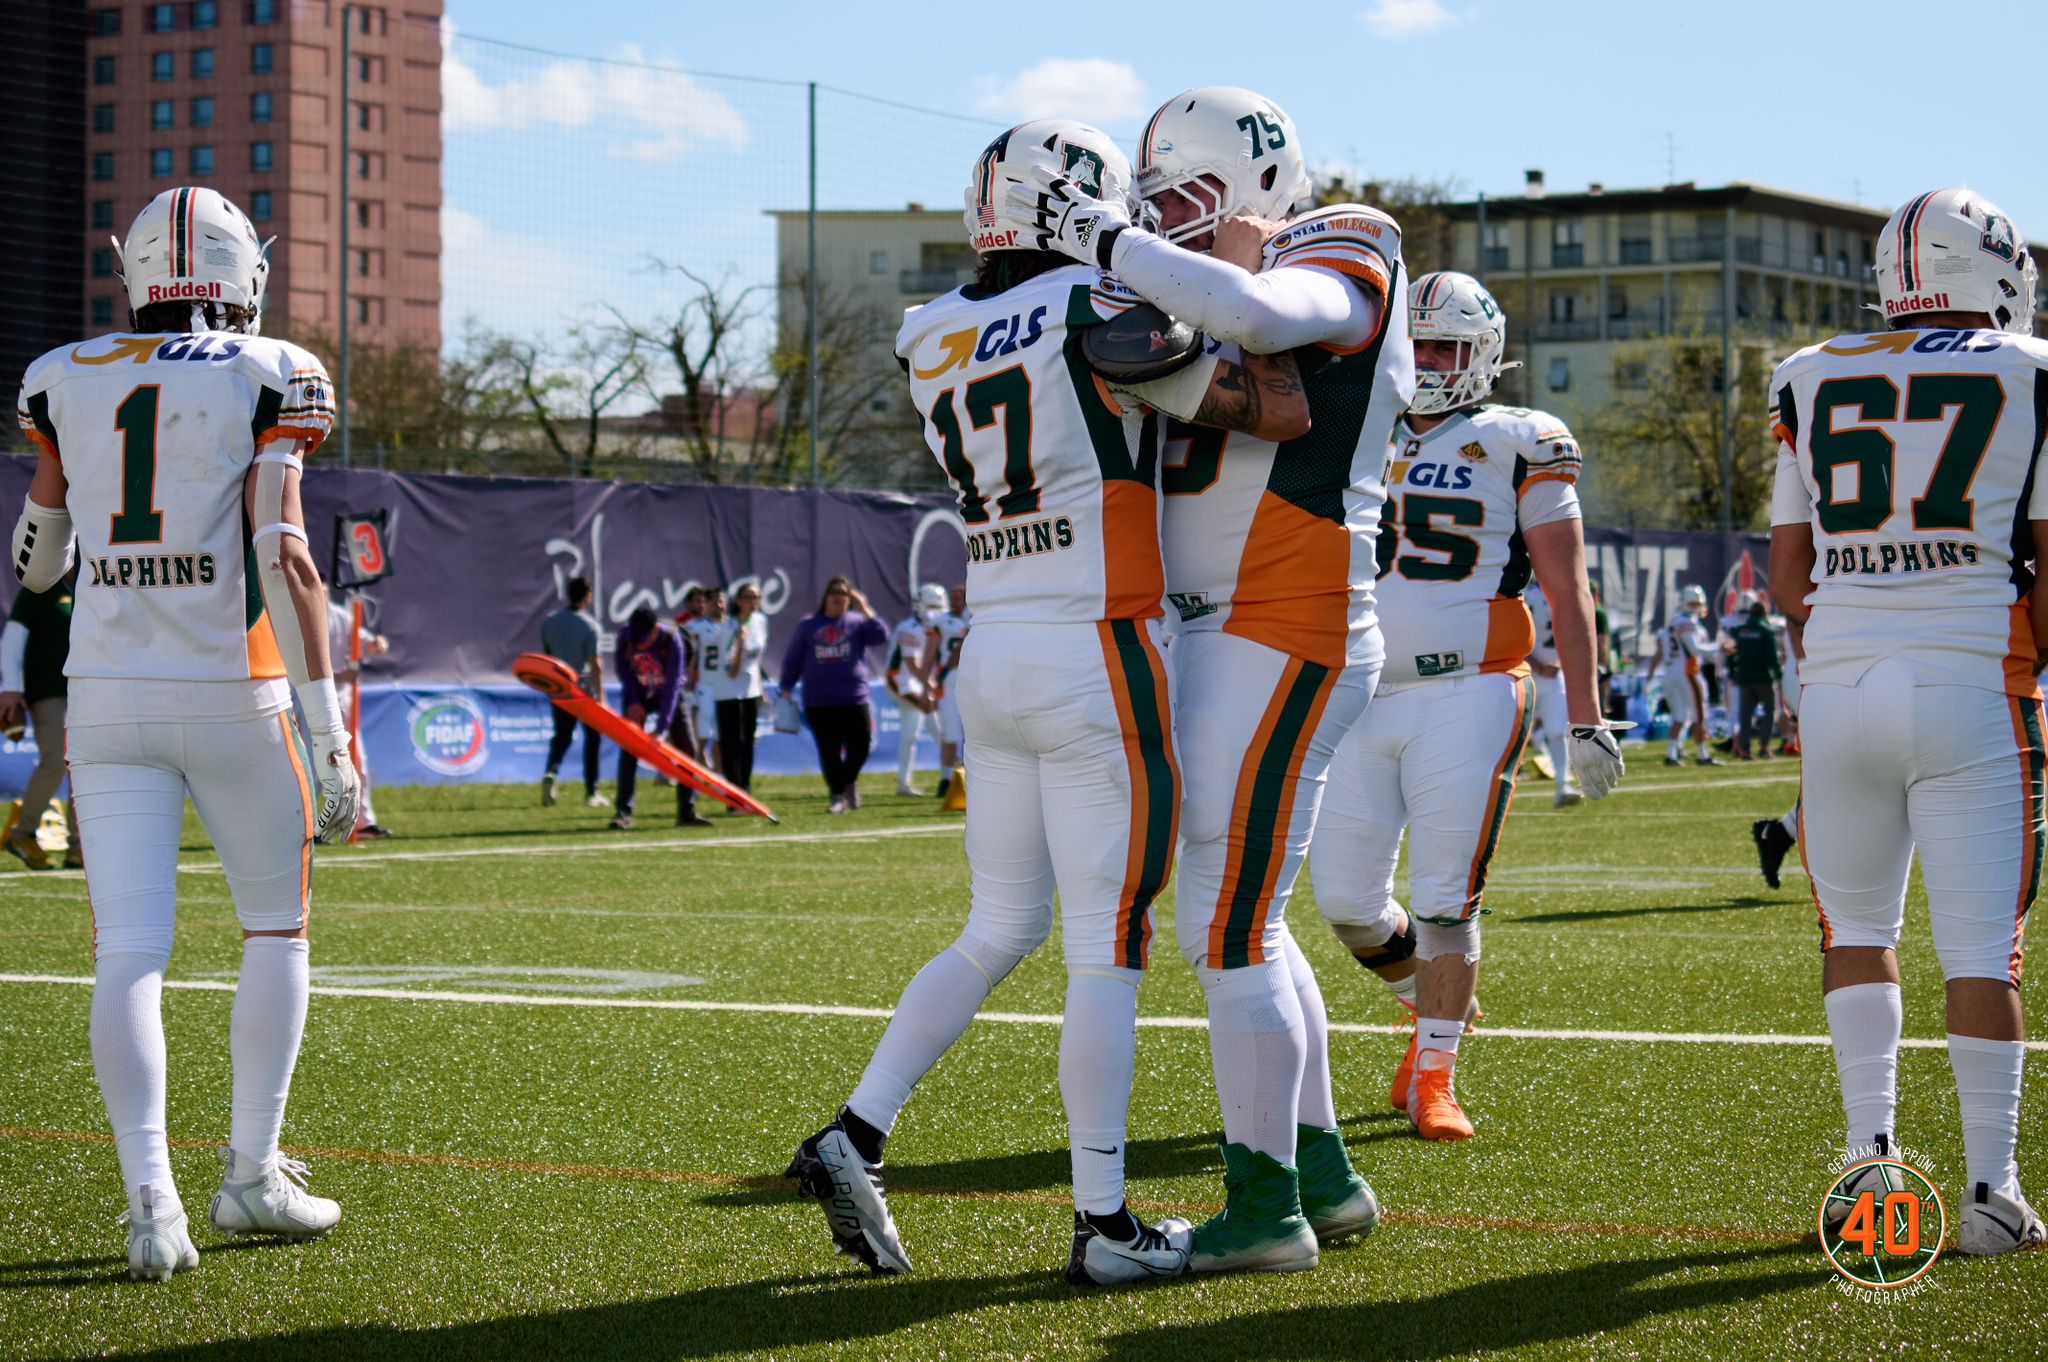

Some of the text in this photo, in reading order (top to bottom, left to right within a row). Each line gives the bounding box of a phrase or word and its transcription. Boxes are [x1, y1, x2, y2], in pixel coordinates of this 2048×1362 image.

[1236, 110, 1286, 159] 75
[1081, 215, 1100, 247] adidas
[1293, 217, 1382, 240] STAR NOLEGGIO
[148, 281, 222, 303] Riddell
[1886, 293, 1950, 316] Riddell
[157, 336, 250, 361] GLS
[975, 305, 1047, 362] GLS
[1913, 331, 2010, 353] GLS
[930, 362, 1043, 526] 17
[1810, 373, 2008, 536] 67
[109, 383, 164, 546] 1
[1408, 463, 1473, 490] GLS
[353, 522, 385, 575] 3
[1825, 539, 1981, 578] DOLPHINS
[705, 645, 719, 671] 2
[425, 725, 474, 744] FIDAF
[817, 1143, 861, 1230] VAPOR
